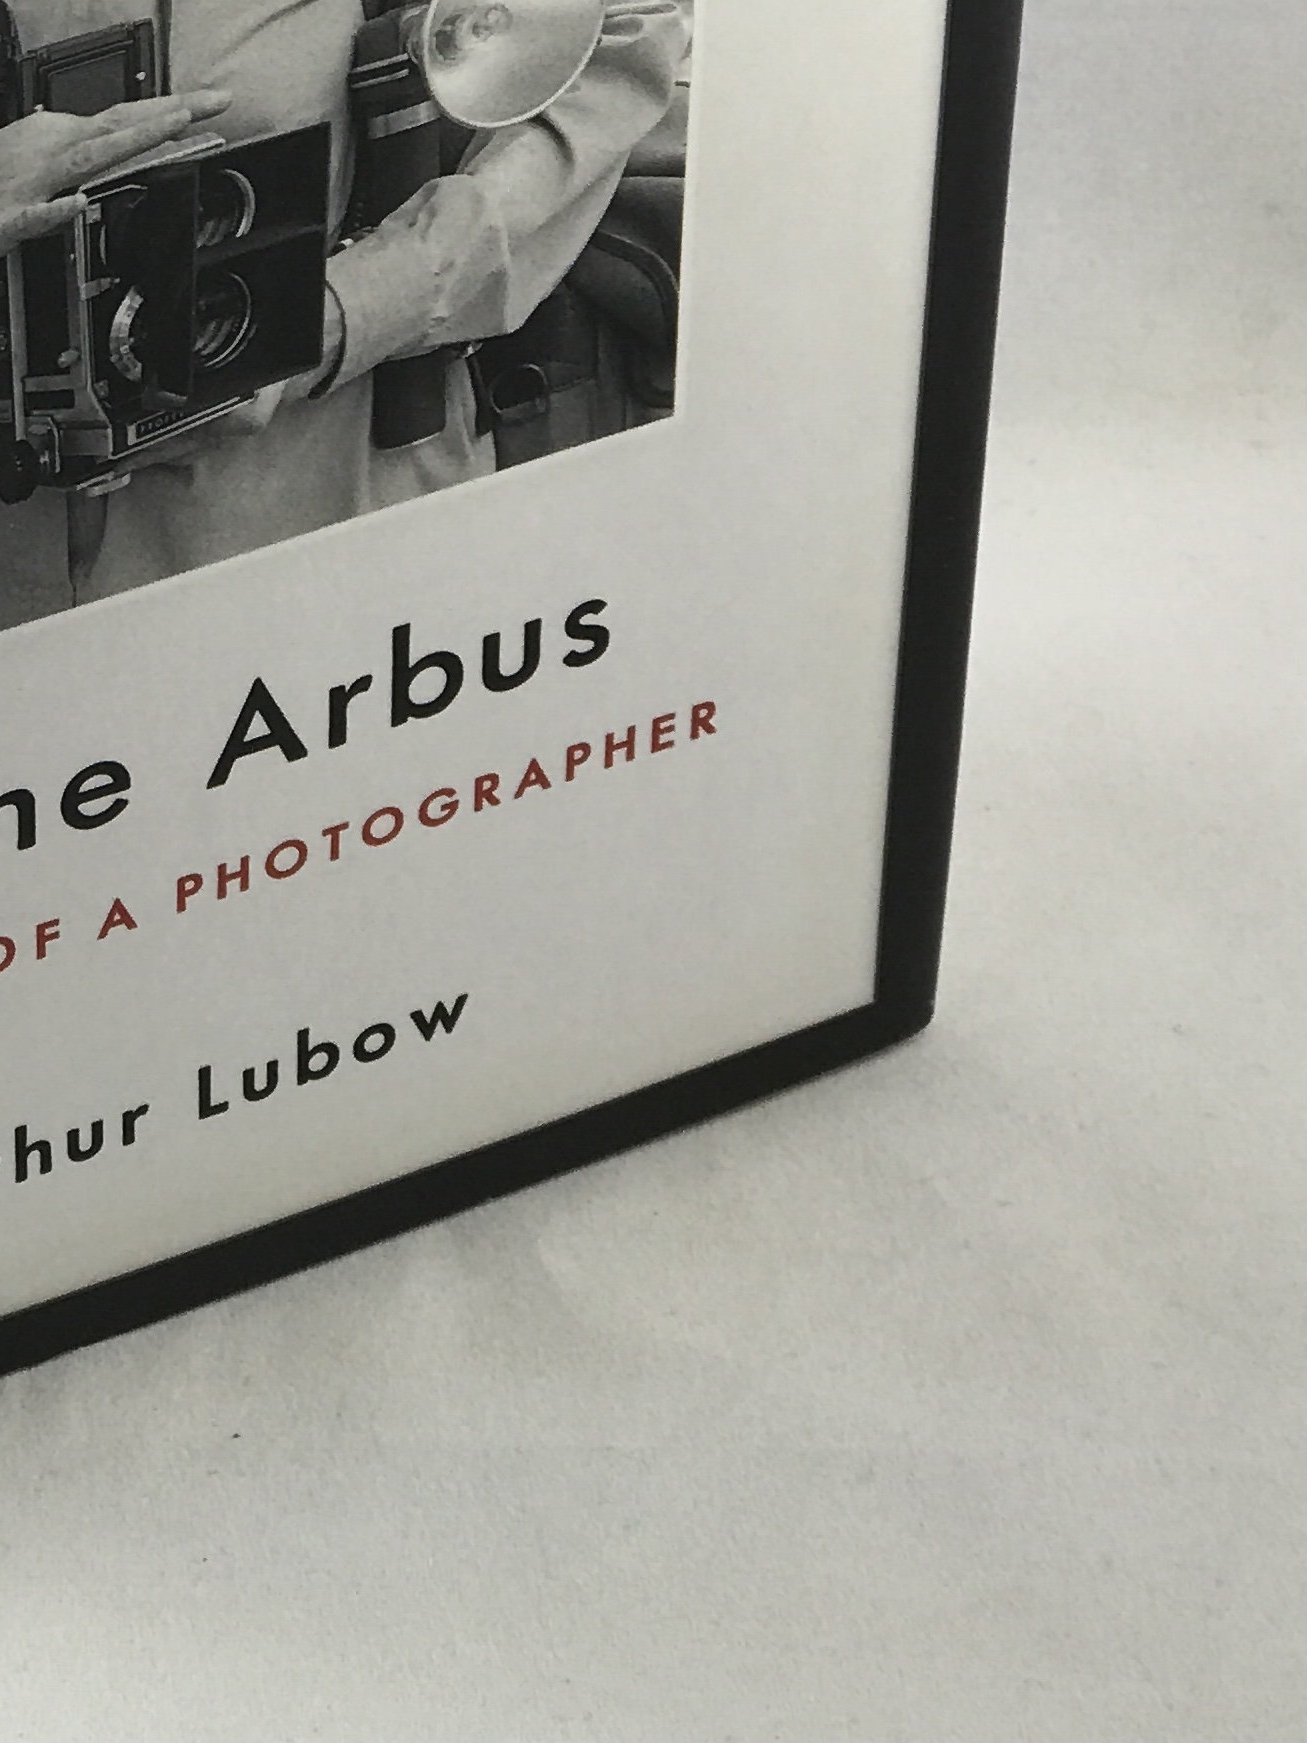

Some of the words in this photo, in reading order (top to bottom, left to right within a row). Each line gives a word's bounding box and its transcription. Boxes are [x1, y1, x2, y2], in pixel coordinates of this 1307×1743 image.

[206, 598, 611, 790] Arbus
[97, 897, 139, 940] A
[176, 700, 719, 914] PHOTOGRAPHER
[198, 992, 470, 1120] Lubow
